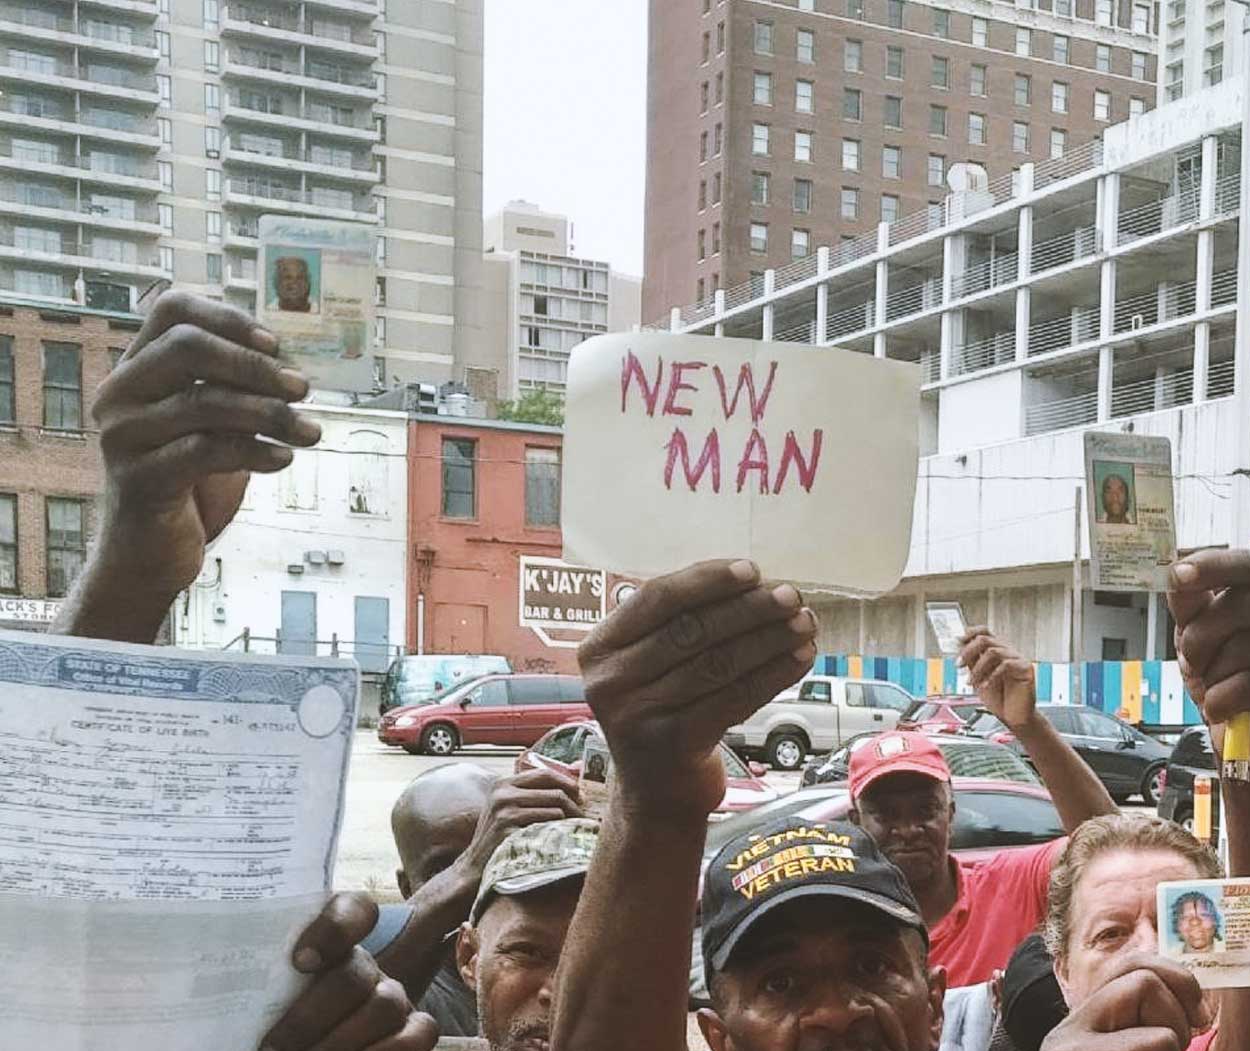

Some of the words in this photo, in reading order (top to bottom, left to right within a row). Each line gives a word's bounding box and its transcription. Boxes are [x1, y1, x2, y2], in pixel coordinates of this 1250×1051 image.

[621, 350, 778, 425] NEW
[664, 427, 823, 495] MAN
[525, 569, 602, 597] K'JAY'S
[525, 606, 549, 619] BAR
[553, 607, 563, 620] &
[566, 608, 601, 623] GRILL
[726, 824, 852, 871] VIETNAM
[741, 857, 857, 900] VETERAN
